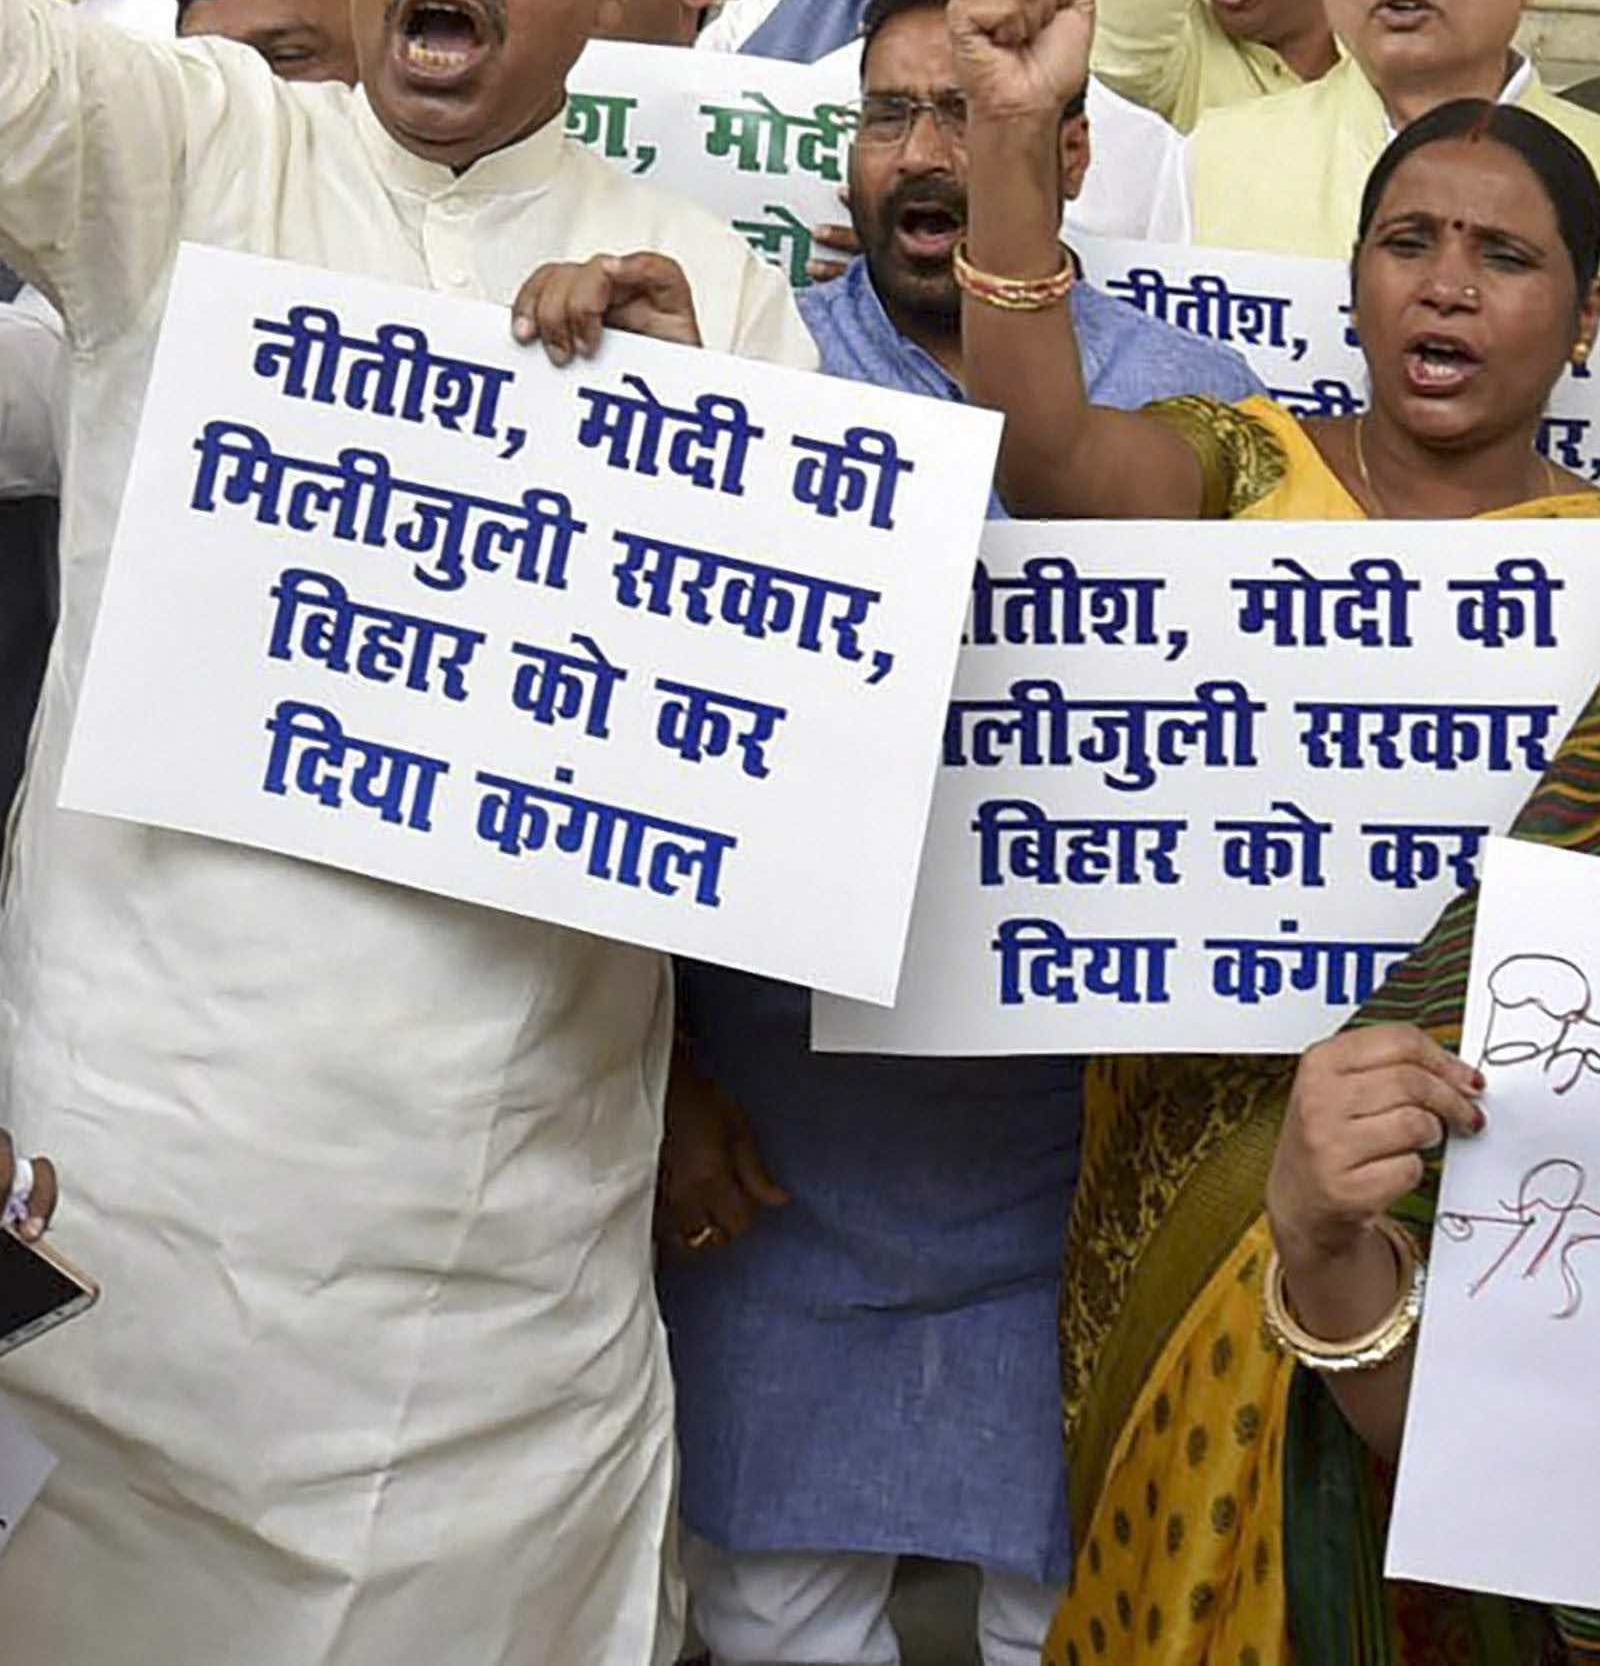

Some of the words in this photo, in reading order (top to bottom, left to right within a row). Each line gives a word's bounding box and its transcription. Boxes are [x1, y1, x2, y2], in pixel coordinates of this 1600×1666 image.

[252, 306, 528, 459] नीतीश,
[577, 374, 761, 494] मोदी
[791, 427, 913, 531] की
[190, 421, 585, 592] मिलीजुली
[612, 529, 898, 684] सरकार,
[1231, 559, 1420, 649] मोदी
[1448, 559, 1564, 649] की
[266, 568, 486, 703] बिहार
[511, 634, 626, 740] को
[655, 677, 786, 780] कर
[262, 700, 449, 834] दिया
[475, 765, 735, 908] कंगाल
[972, 800, 1188, 889] बिहार
[1215, 801, 1331, 889] को
[1361, 824, 1490, 891] कर
[991, 919, 1176, 1006] दिया
